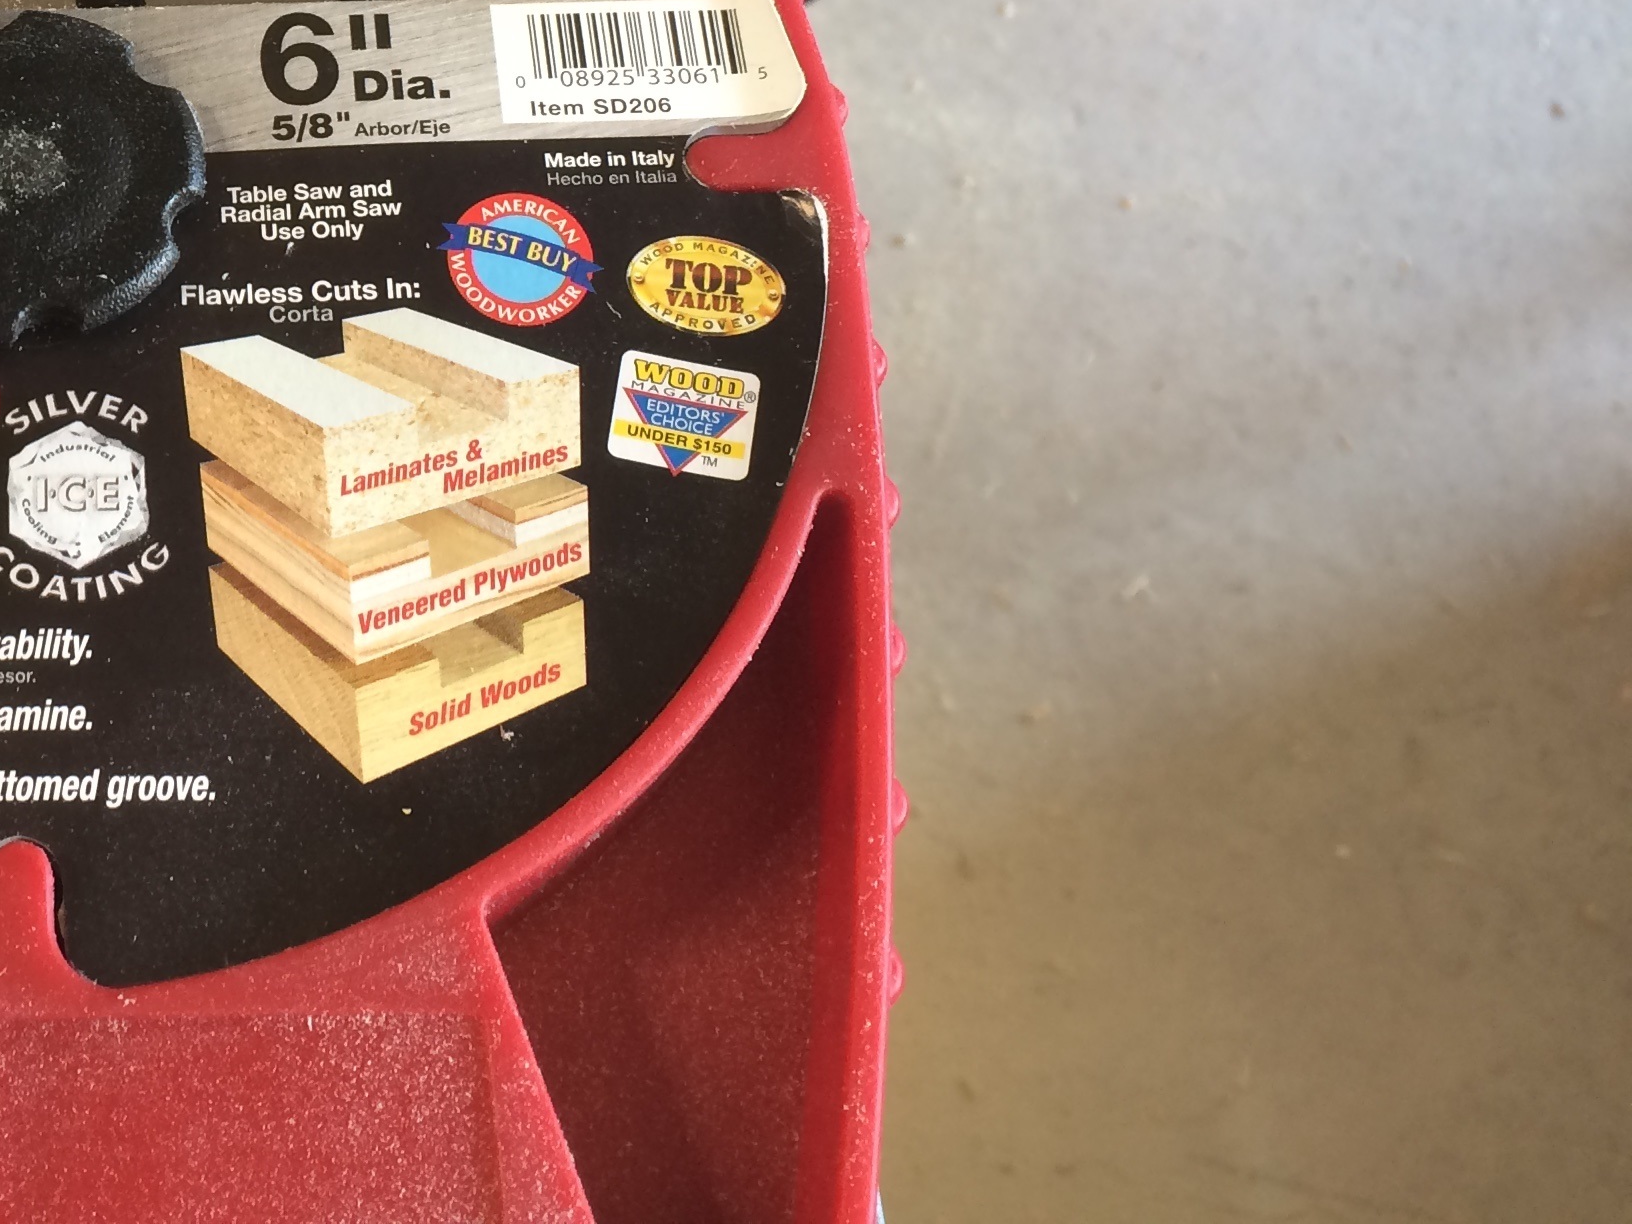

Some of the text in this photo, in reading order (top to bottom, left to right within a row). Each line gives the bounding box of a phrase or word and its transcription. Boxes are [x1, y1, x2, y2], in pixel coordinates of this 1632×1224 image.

[260, 11, 452, 106] 6" Dia.
[515, 66, 769, 89] 0 08925 33061 5
[530, 97, 673, 117] Item SD206
[271, 112, 451, 143] 5/8" Arbor/Eje
[544, 149, 676, 170] Made in Italy
[226, 179, 393, 206] Table Saw and
[546, 169, 678, 187] Hecho en Italia
[220, 198, 403, 224] Radial Arm Saw
[480, 197, 580, 246] AMERICAN
[260, 219, 365, 242] Use Only
[467, 226, 578, 273] BEST BUY
[640, 242, 775, 285] WOOD MAGAZINE
[180, 278, 422, 306] Flawless Cuts In:
[449, 252, 583, 324] WOODWORKER
[665, 258, 753, 297] TOP
[268, 305, 335, 323] Corta
[649, 300, 757, 330] APPROVED
[665, 288, 745, 314] VALUE
[630, 379, 746, 411] MAGAZINE
[646, 399, 725, 422] EDITORS'
[5, 389, 149, 435] SILVER
[650, 412, 713, 436] CHOICE
[40, 444, 116, 462] Industrial
[627, 424, 732, 456] UNDER $150
[339, 439, 483, 496] Laminates &
[442, 444, 569, 494] Melamines
[22, 497, 57, 545] Cooling
[98, 495, 134, 543] Element
[357, 541, 582, 634] Veneered Plywoods
[409, 662, 561, 737] Solid Woods
[105, 774, 216, 808] groove.
